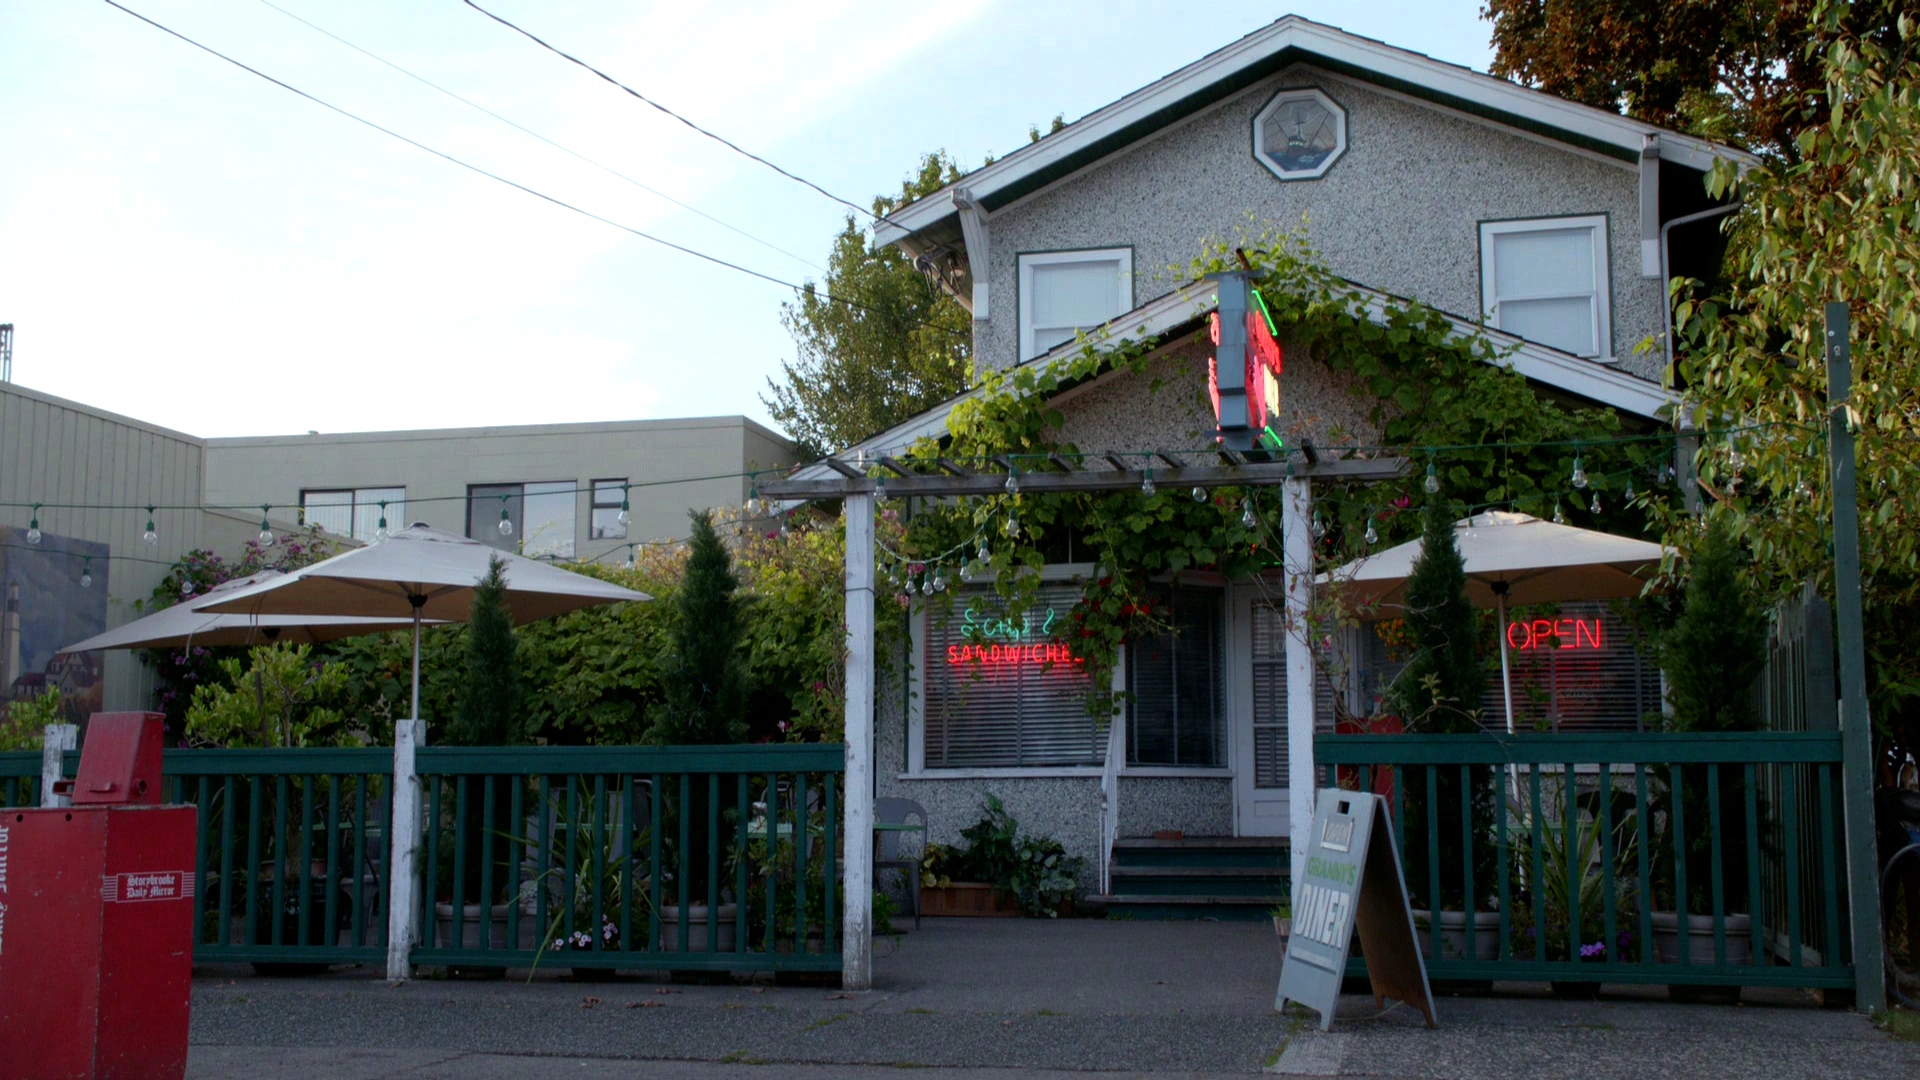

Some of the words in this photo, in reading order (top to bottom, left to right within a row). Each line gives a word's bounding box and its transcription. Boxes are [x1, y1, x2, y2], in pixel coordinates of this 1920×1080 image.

[1507, 618, 1601, 649] OPEN
[947, 643, 1085, 664] SANDWICHE
[126, 873, 175, 888] Storybrooke
[1307, 856, 1356, 886] GRANNY'S
[127, 886, 148, 899] Daily
[149, 885, 175, 898] Mirror
[1294, 883, 1350, 950] DINER
